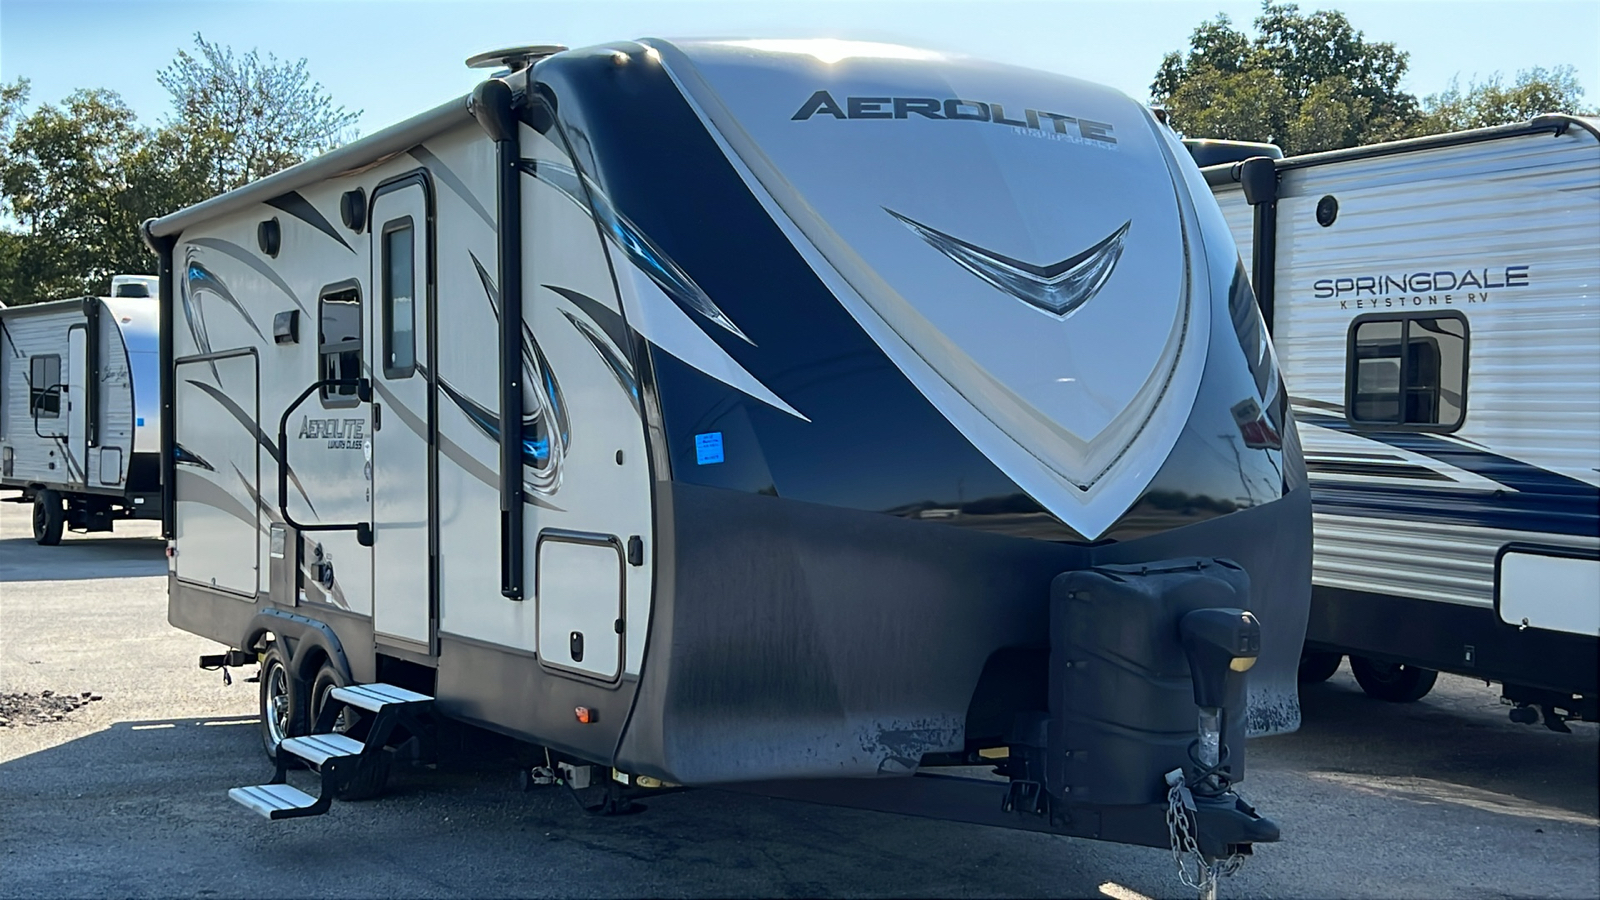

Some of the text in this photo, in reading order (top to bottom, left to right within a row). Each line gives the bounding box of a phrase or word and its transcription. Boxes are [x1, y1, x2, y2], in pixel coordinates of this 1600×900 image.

[790, 89, 1118, 144] AEROLITE
[1313, 265, 1529, 298] SPRINGDALE
[1340, 292, 1488, 310] KEYSTONE RV
[298, 414, 365, 439] AEROLITE
[346, 440, 362, 449] CLASS
